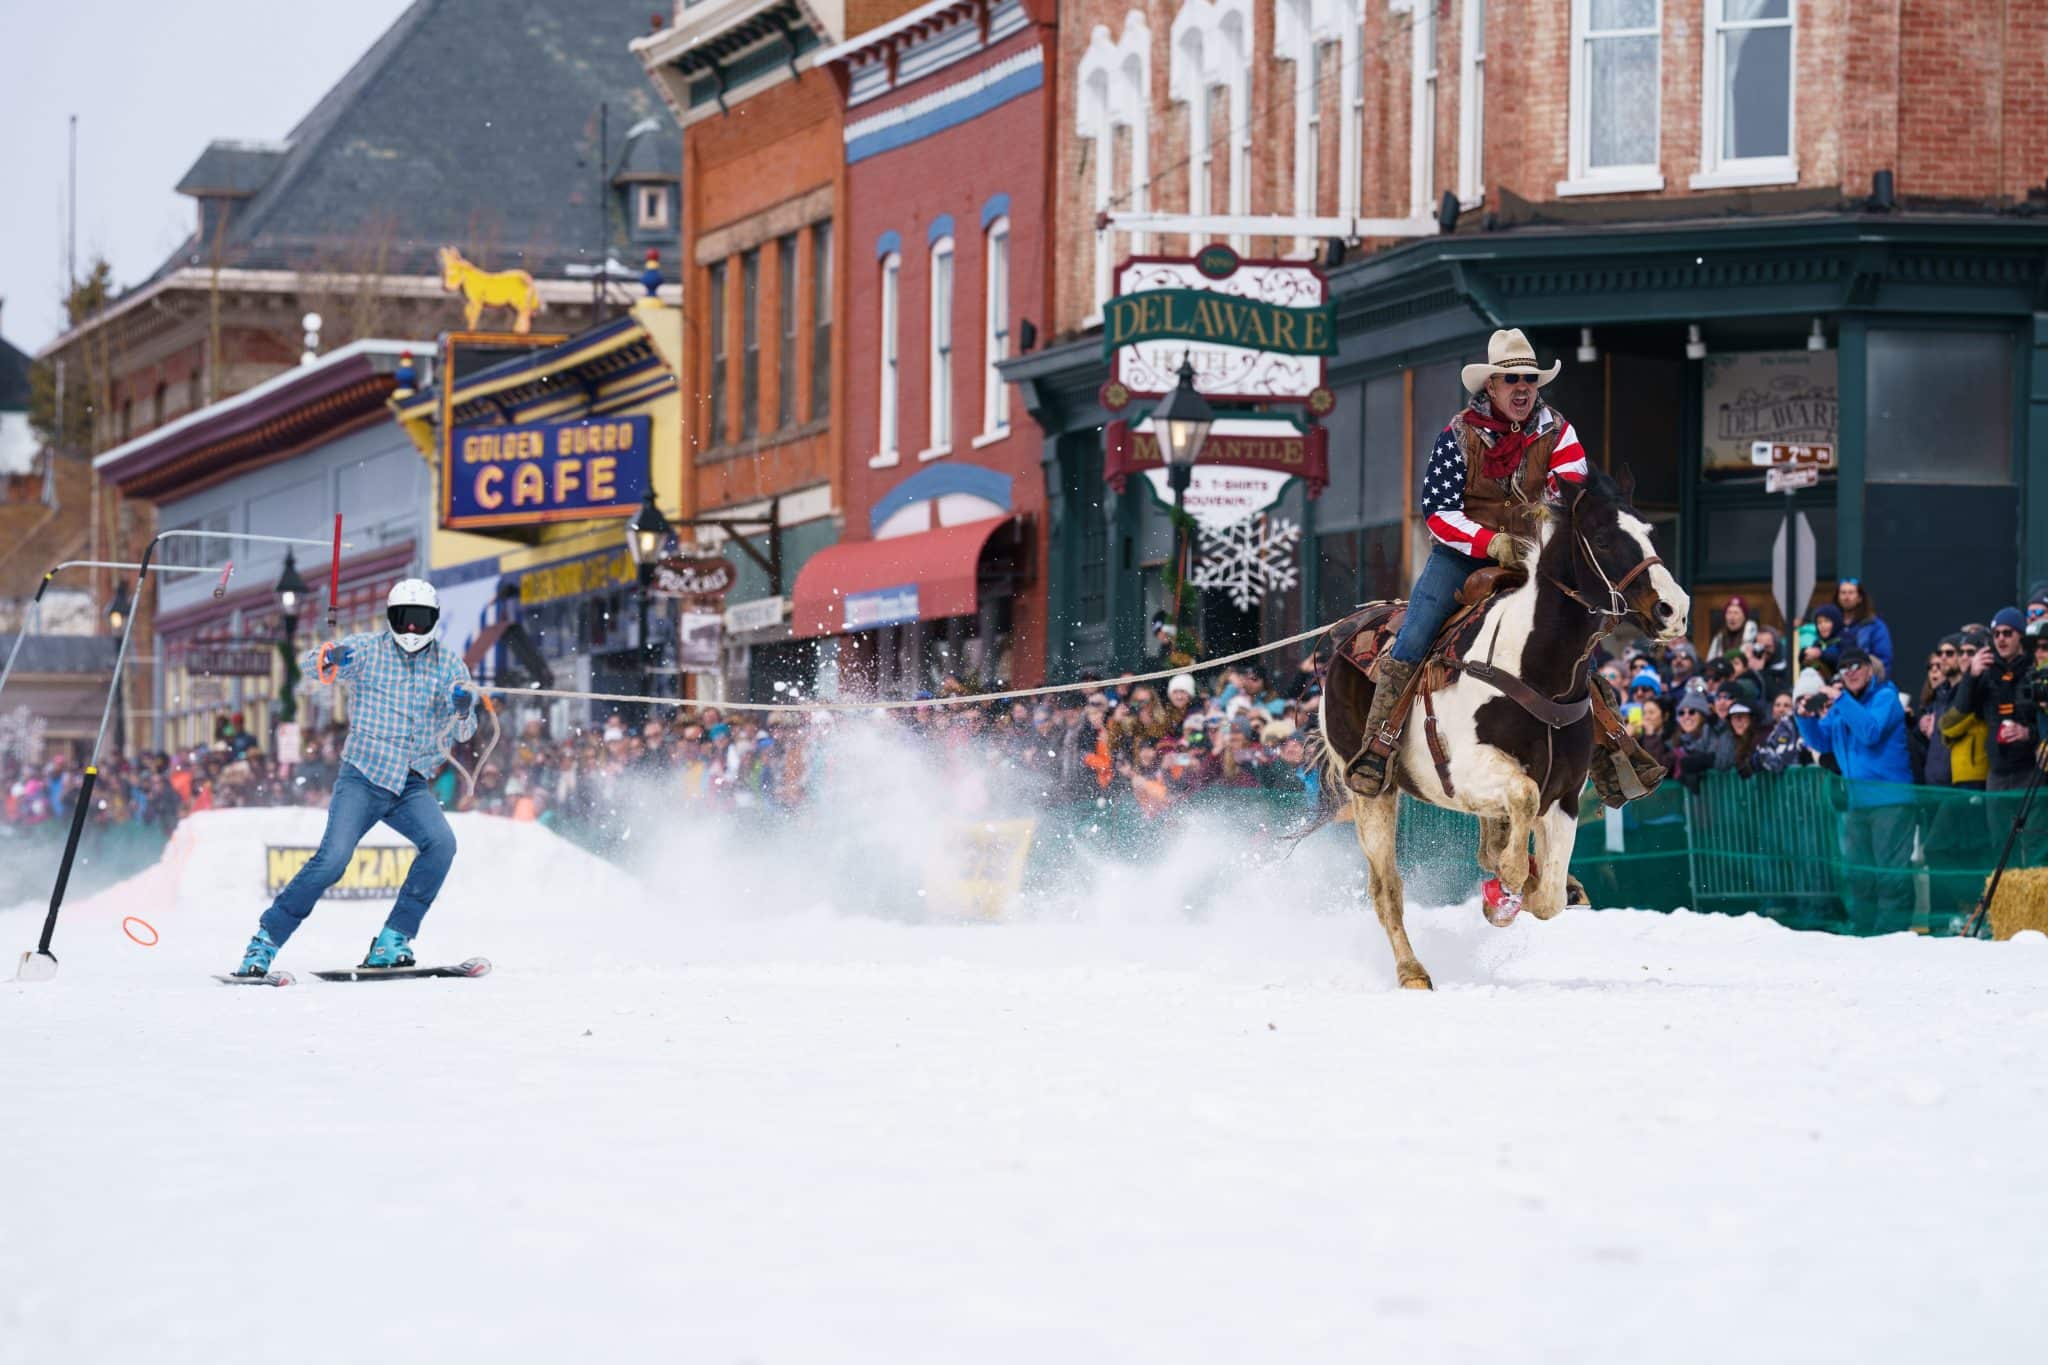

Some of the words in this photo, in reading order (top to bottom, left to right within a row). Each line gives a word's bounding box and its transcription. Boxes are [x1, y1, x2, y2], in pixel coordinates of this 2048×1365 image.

[1112, 295, 1329, 350] DELAWARE
[462, 430, 545, 464] GOLDEN
[557, 421, 634, 457] BURRO
[1132, 436, 1304, 464] MANTILE
[474, 456, 617, 509] CAFE
